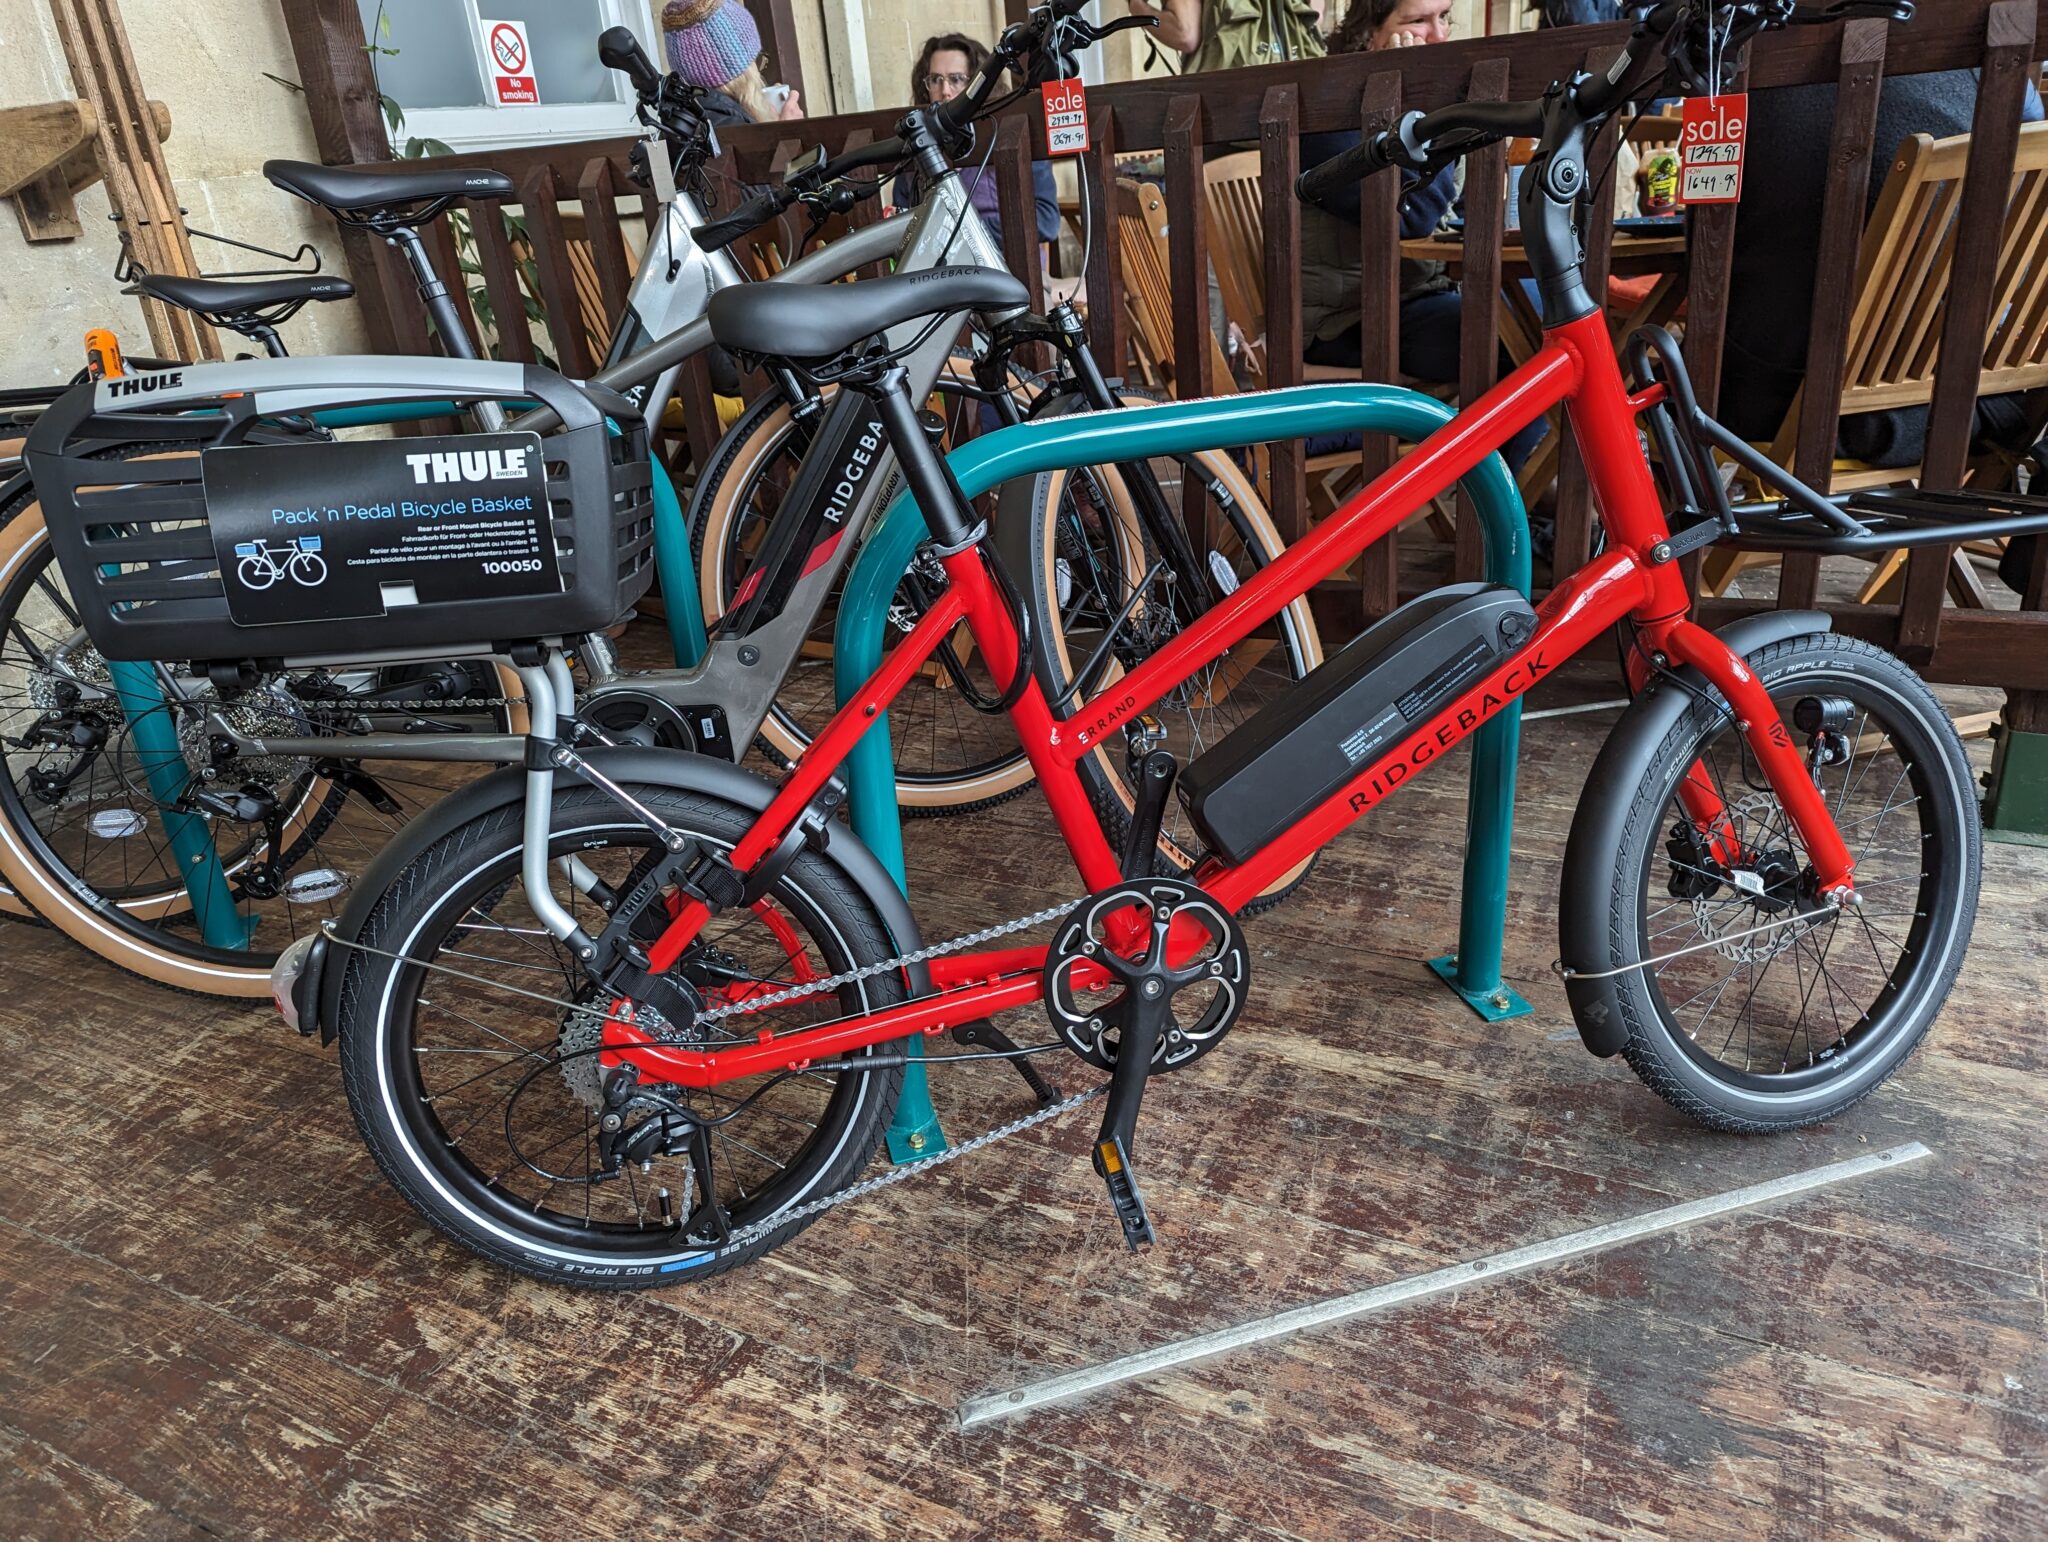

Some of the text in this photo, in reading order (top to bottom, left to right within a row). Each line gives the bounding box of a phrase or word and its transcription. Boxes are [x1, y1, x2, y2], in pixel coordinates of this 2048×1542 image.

[510, 78, 522, 88] No
[502, 90, 535, 101] smoking
[1046, 86, 1083, 113] sale
[1686, 106, 1743, 142] sale
[909, 268, 982, 286] RIDGEBACK
[108, 372, 183, 398] THULE
[406, 448, 529, 484] THULE
[495, 470, 523, 478] SWEDEN
[824, 421, 884, 523] RIDGEBA
[271, 507, 319, 525] Pack
[344, 502, 396, 520] Pedal
[401, 499, 467, 518] Bicycle
[471, 496, 533, 513] Basket
[402, 534, 439, 543] Fahrradkorb
[469, 531, 483, 539] oder
[484, 529, 526, 538] Heckmontage
[441, 524, 459, 532] Front
[460, 522, 479, 530] Mount
[480, 521, 502, 529] Bicycle
[503, 520, 524, 528] Basket
[347, 558, 366, 566] Cesta
[381, 555, 407, 563] bicicleta
[457, 551, 474, 559] parte
[474, 549, 503, 557] delantera
[369, 547, 389, 555] Panier
[438, 542, 466, 550] montage
[481, 559, 543, 574] 100050
[1762, 669, 1783, 684] BIG
[1786, 660, 1828, 674] APPLE
[1077, 696, 1136, 745] ERRAND
[1347, 651, 1550, 812] RIDGEBACK
[620, 881, 651, 916] THULE
[563, 1263, 654, 1276] BIG APPLE
